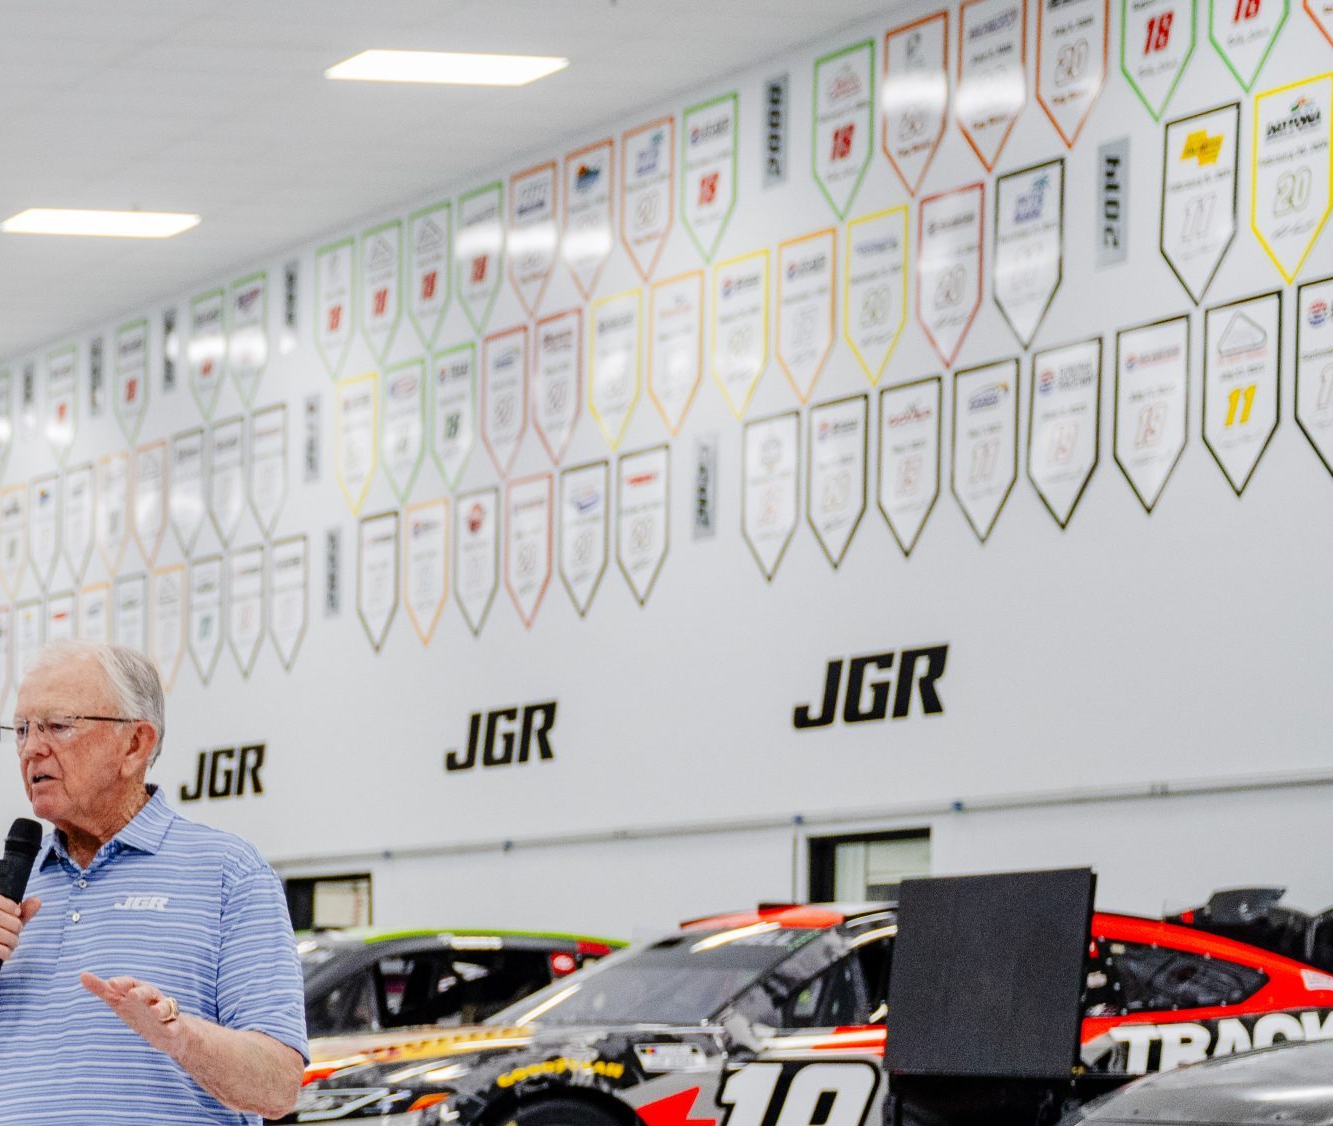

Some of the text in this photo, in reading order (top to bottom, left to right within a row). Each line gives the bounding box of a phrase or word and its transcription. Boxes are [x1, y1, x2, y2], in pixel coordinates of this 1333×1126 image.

[1143, 11, 1173, 55] 18
[1273, 164, 1313, 218] 20
[1223, 383, 1258, 428] 11
[793, 644, 949, 730] JGR
[445, 701, 557, 772] JGR
[180, 744, 265, 802] JGR
[113, 895, 169, 911] JGR
